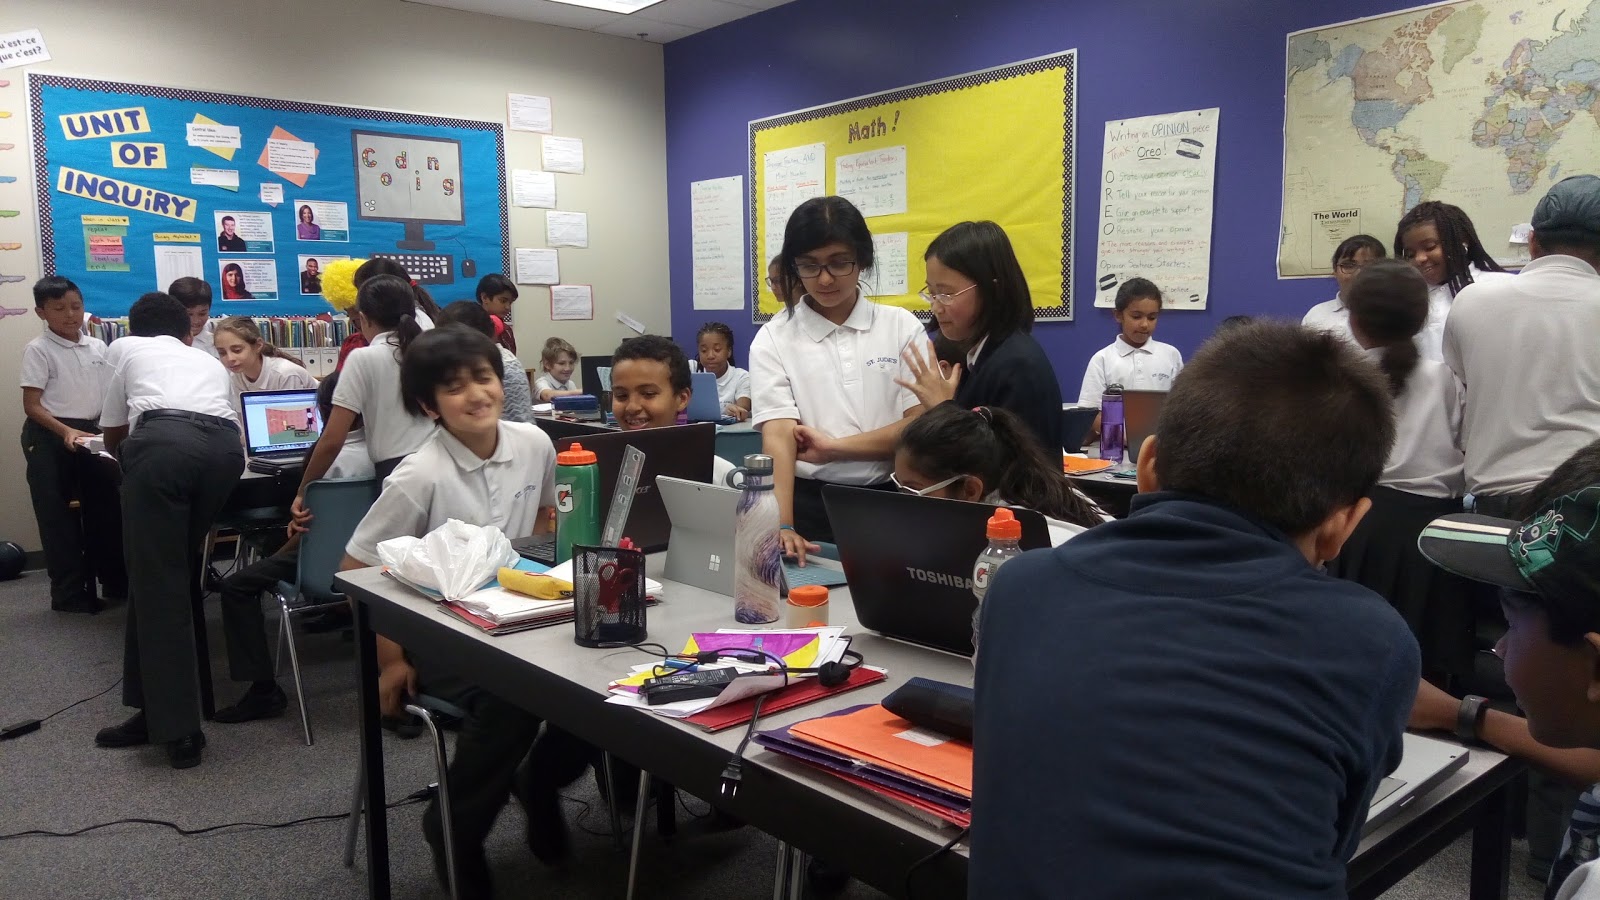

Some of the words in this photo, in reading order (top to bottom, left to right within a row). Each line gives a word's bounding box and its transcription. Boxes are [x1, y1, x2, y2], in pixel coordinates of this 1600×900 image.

[0, 37, 37, 50] u'est-ce
[66, 110, 140, 138] UNIT
[848, 116, 887, 144] Math
[1152, 121, 1190, 136] OPINION
[119, 143, 158, 166] OF
[1105, 170, 1114, 183] O
[1105, 187, 1113, 200] R
[1104, 204, 1113, 218] E
[1313, 212, 1330, 220] The
[1331, 209, 1358, 219] World
[1103, 222, 1115, 235] O
[906, 566, 973, 590] TOSHIBA
